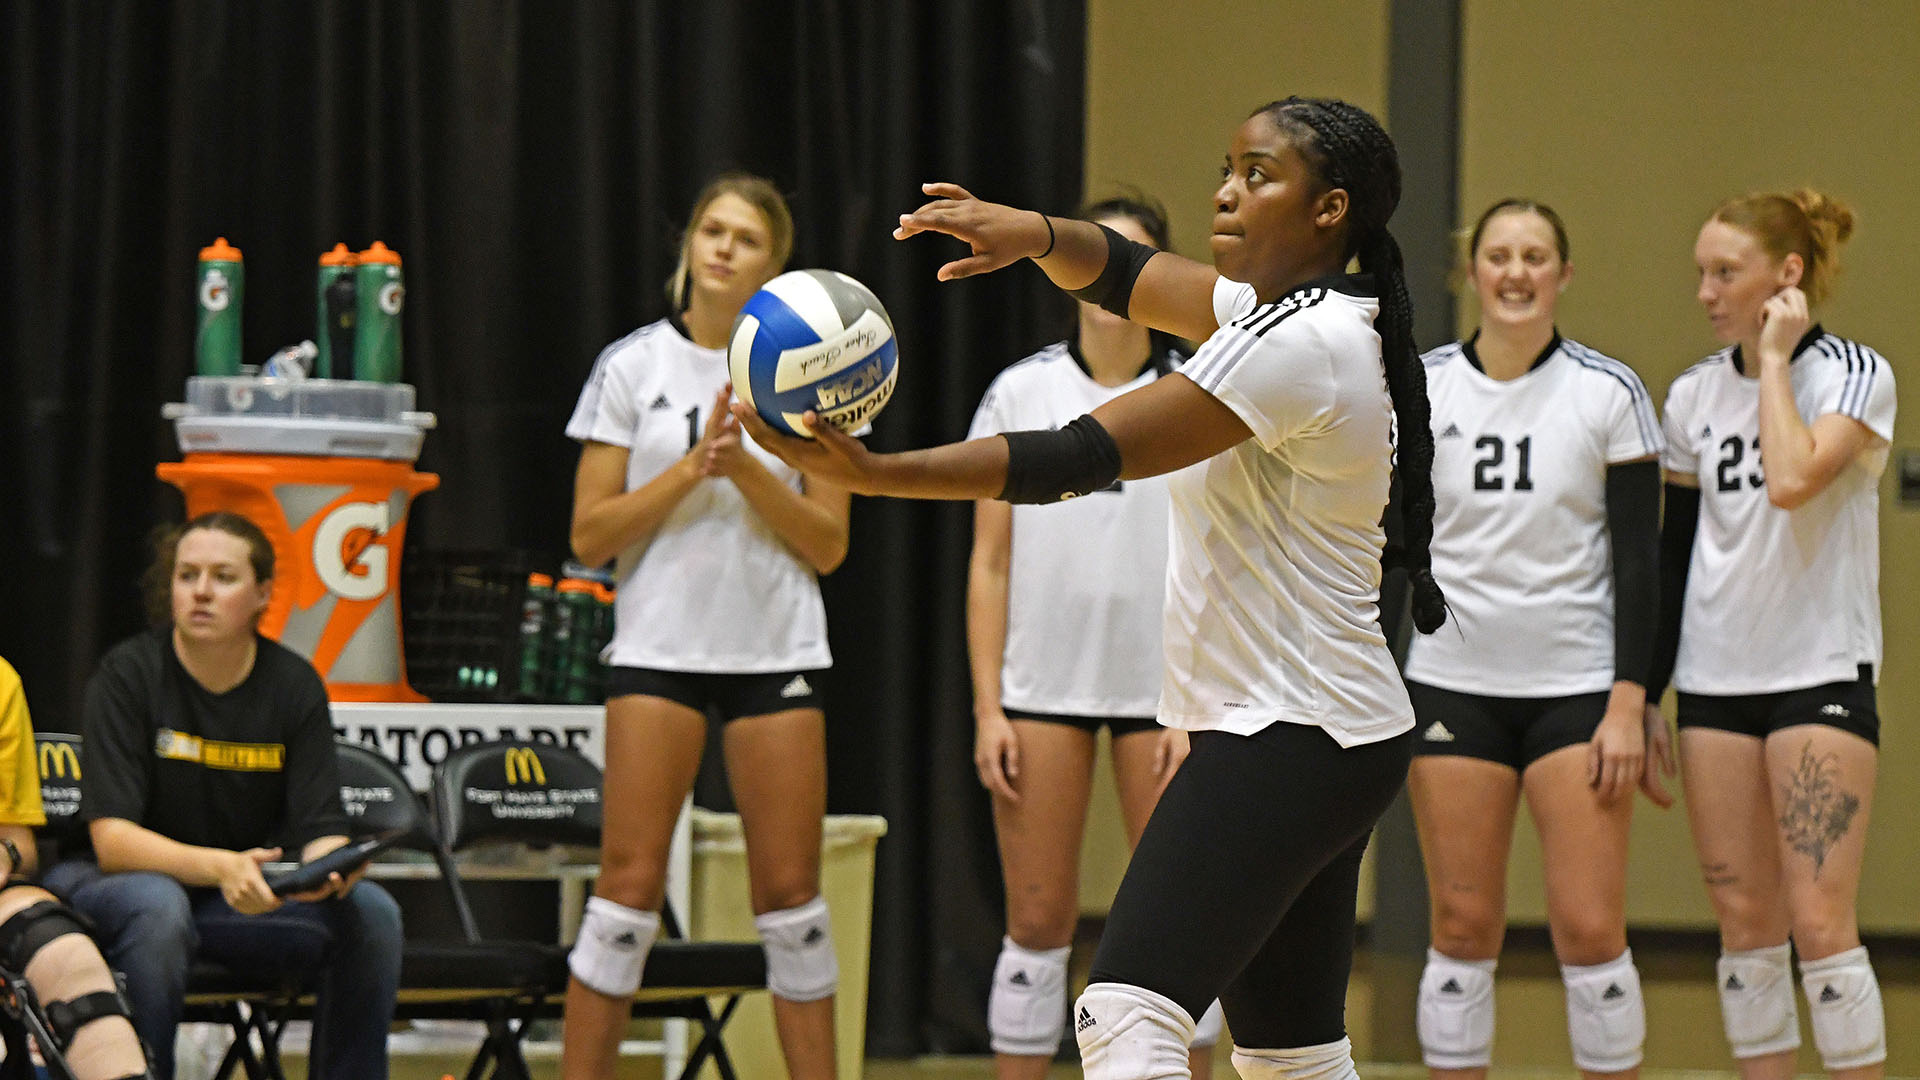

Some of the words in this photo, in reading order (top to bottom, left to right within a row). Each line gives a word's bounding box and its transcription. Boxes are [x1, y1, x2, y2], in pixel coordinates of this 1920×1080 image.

[800, 349, 842, 376] Touch
[844, 329, 877, 350] Super
[816, 356, 884, 410] NCAA
[1474, 434, 1534, 491] 21
[313, 500, 389, 601] G
